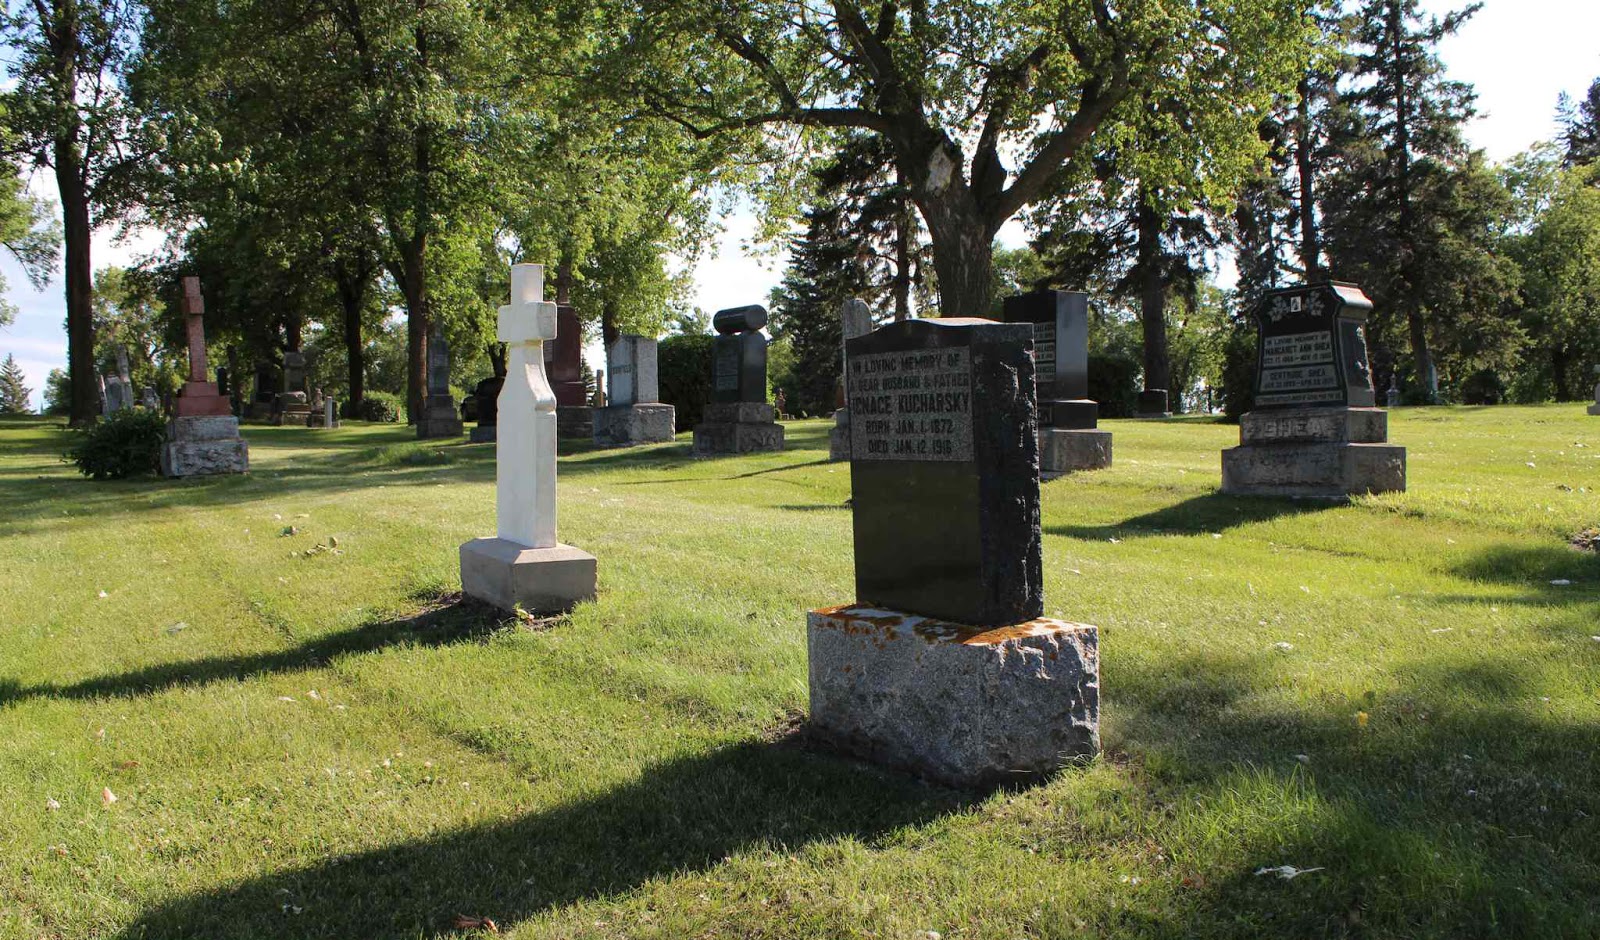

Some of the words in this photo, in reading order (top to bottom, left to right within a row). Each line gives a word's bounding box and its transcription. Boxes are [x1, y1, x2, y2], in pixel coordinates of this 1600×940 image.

[1314, 342, 1331, 352] SHEA
[852, 360, 862, 374] IN
[865, 357, 897, 373] LOVING
[901, 353, 942, 370] MEMORY
[947, 353, 961, 367] OF
[1308, 368, 1326, 378] SHEA
[858, 377, 879, 392] DEAR
[882, 375, 921, 390] HUSBAND
[934, 372, 969, 388] FATHER
[851, 395, 893, 415] IGNACE
[898, 392, 970, 414] KUCHARSKY
[865, 419, 890, 434] BORN
[930, 418, 954, 434] 1872
[868, 439, 889, 454] DIED
[932, 439, 952, 455] 1916
